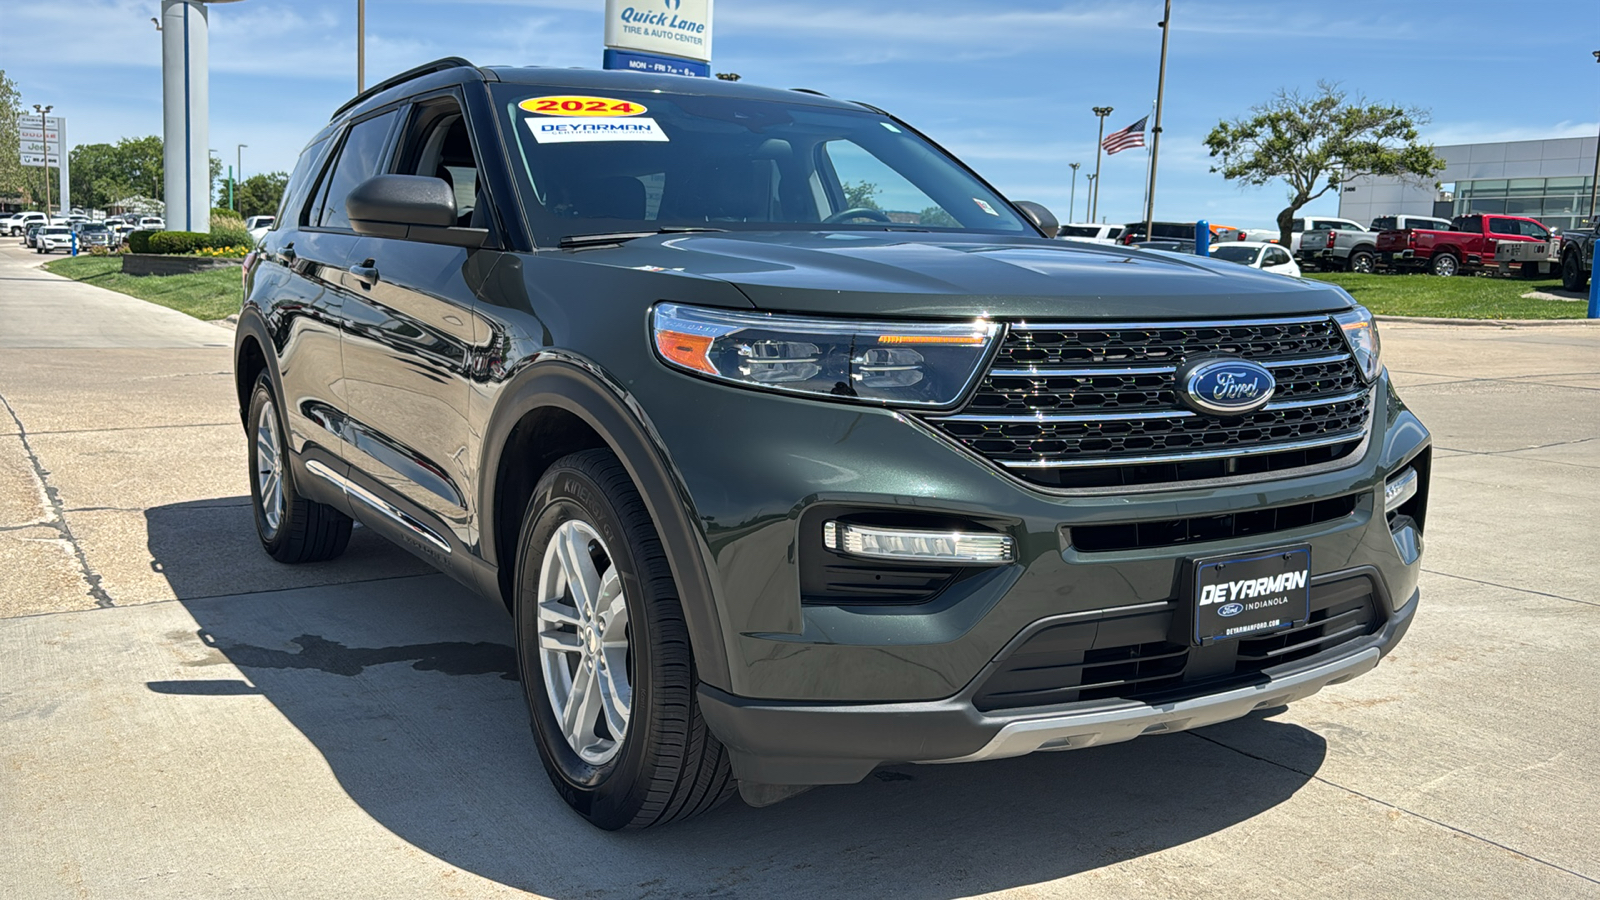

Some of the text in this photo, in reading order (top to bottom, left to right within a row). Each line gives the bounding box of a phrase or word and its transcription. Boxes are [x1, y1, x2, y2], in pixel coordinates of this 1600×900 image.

[621, 7, 705, 34] Quick Lane
[623, 25, 703, 46] TIRE & AUTO CENTER
[629, 60, 647, 69] MON
[654, 63, 666, 72] FRI
[535, 100, 635, 113] 2024
[541, 123, 651, 132] DEYARMAN
[1213, 371, 1259, 400] Ford
[1199, 569, 1308, 606] DEYARMAN
[1245, 596, 1289, 611] INDIANOLA
[1226, 619, 1280, 636] DEYARMANFORD.COM
